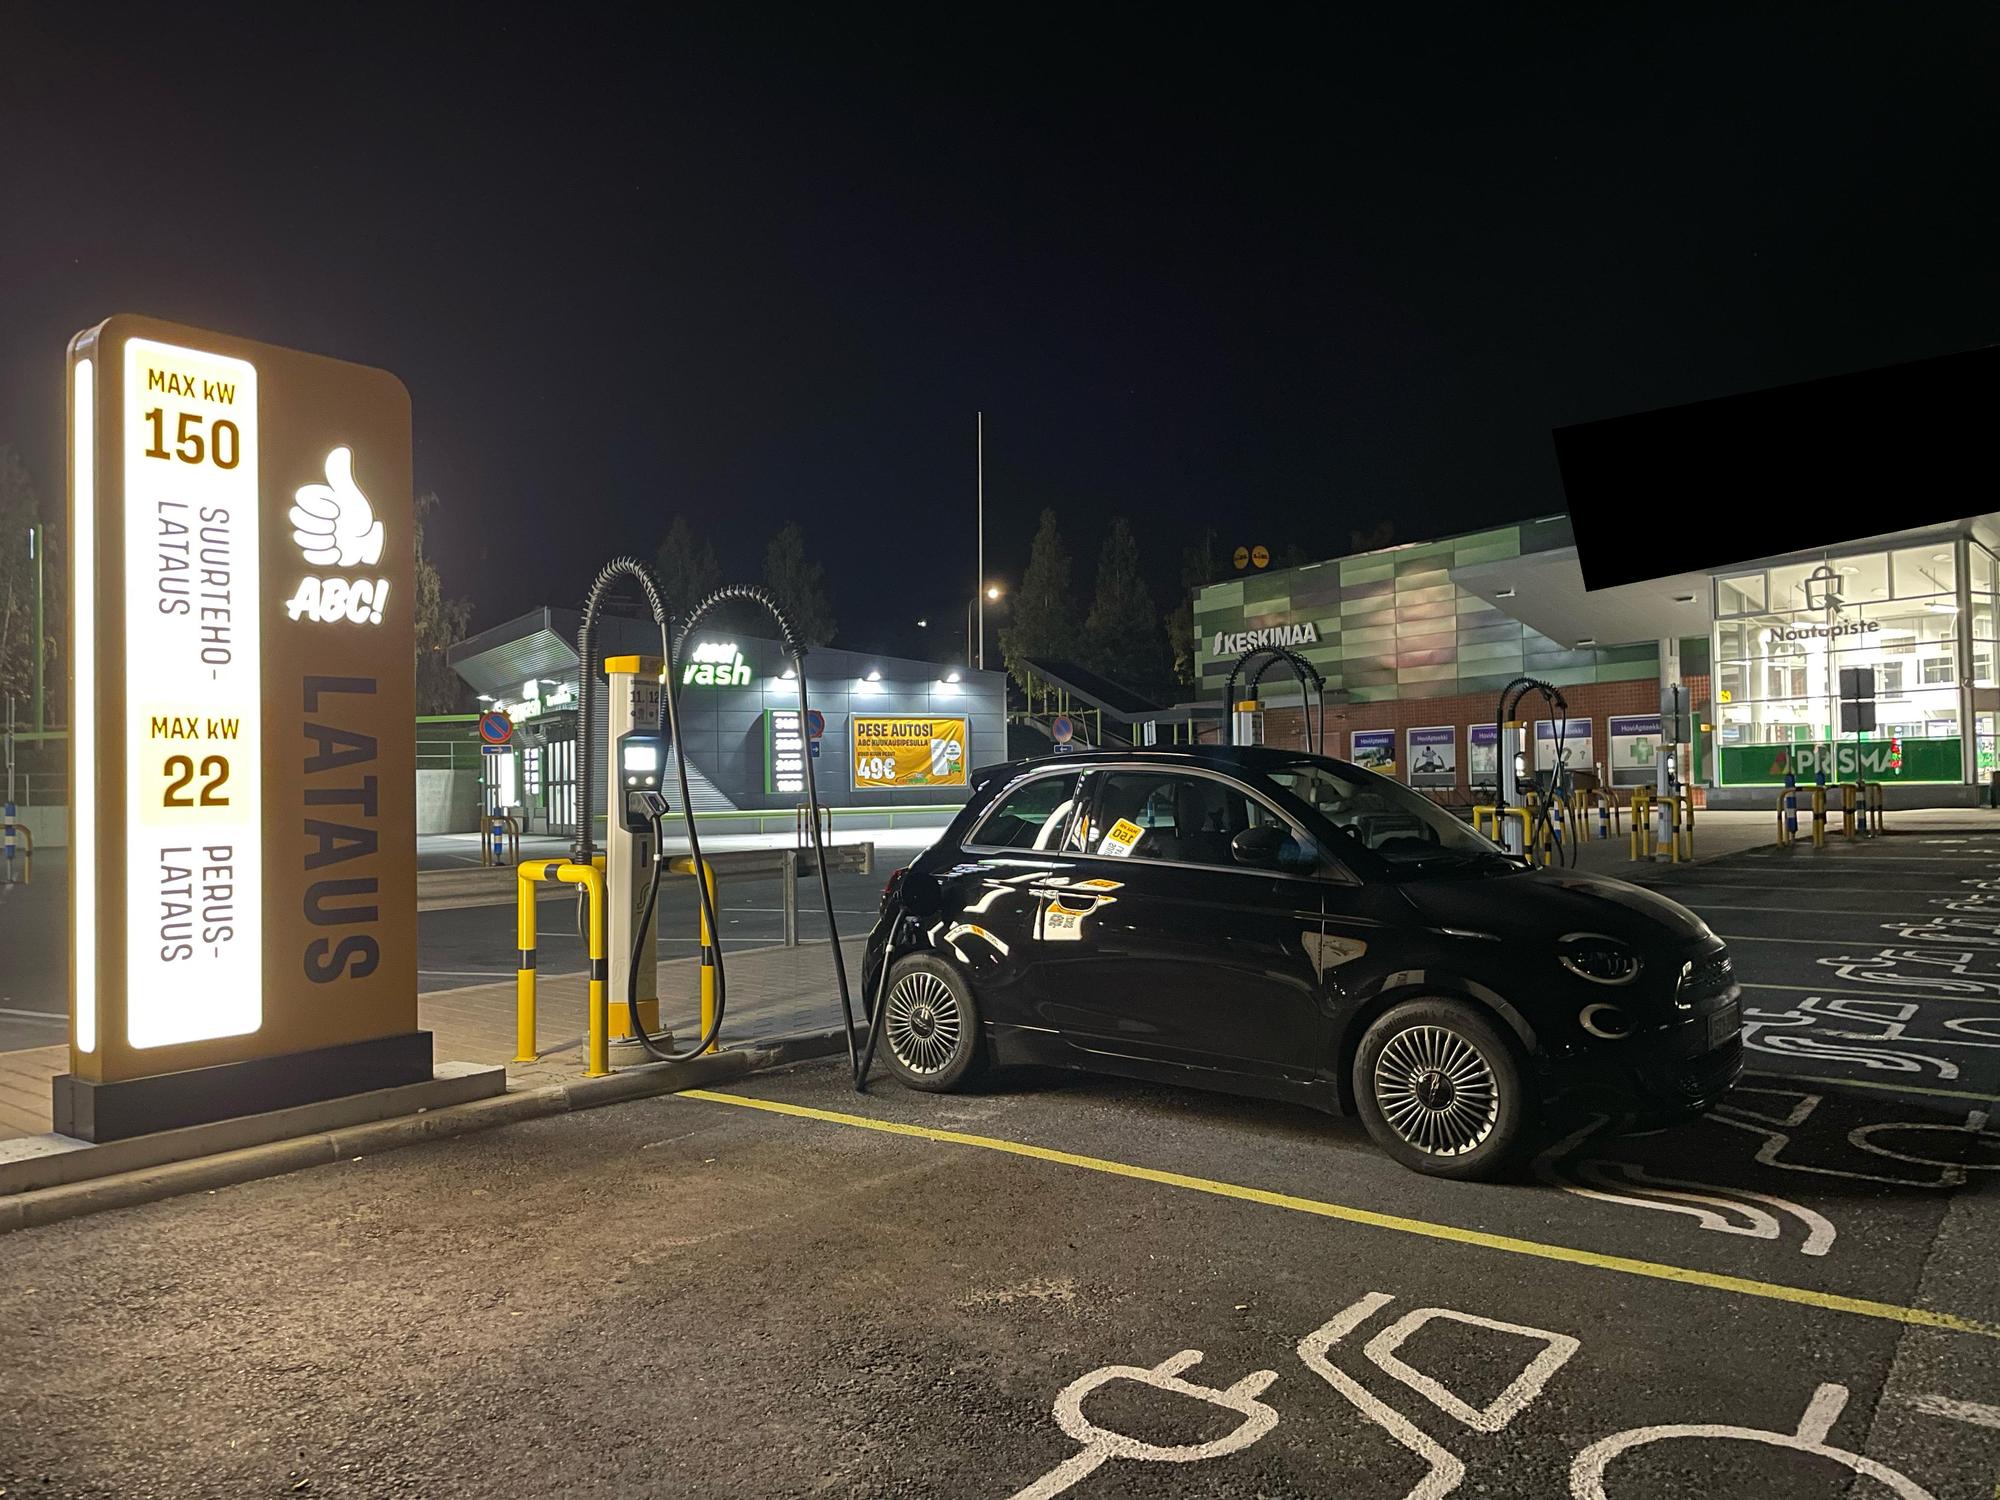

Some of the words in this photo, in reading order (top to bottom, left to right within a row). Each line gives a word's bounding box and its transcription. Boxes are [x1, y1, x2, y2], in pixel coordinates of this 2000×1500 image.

[148, 368, 196, 398] MAX
[204, 380, 236, 405] kW
[144, 407, 241, 470] 150
[157, 501, 190, 616] LATAUS
[199, 506, 232, 680] SUURTEHO-
[285, 576, 390, 625] ABC!
[1224, 622, 1317, 654] KESKIMAA
[1770, 619, 1880, 642] Noutopiste
[152, 717, 199, 740] MAX
[207, 718, 240, 740] kW
[857, 738, 871, 747] ABC
[858, 723, 889, 737] PESE
[891, 723, 933, 737] AUTOSI
[163, 755, 230, 807] 22
[857, 757, 896, 780] 49€
[303, 675, 380, 984] LATAUS
[160, 847, 193, 962] LATAUS
[202, 845, 234, 959] PERUS-
